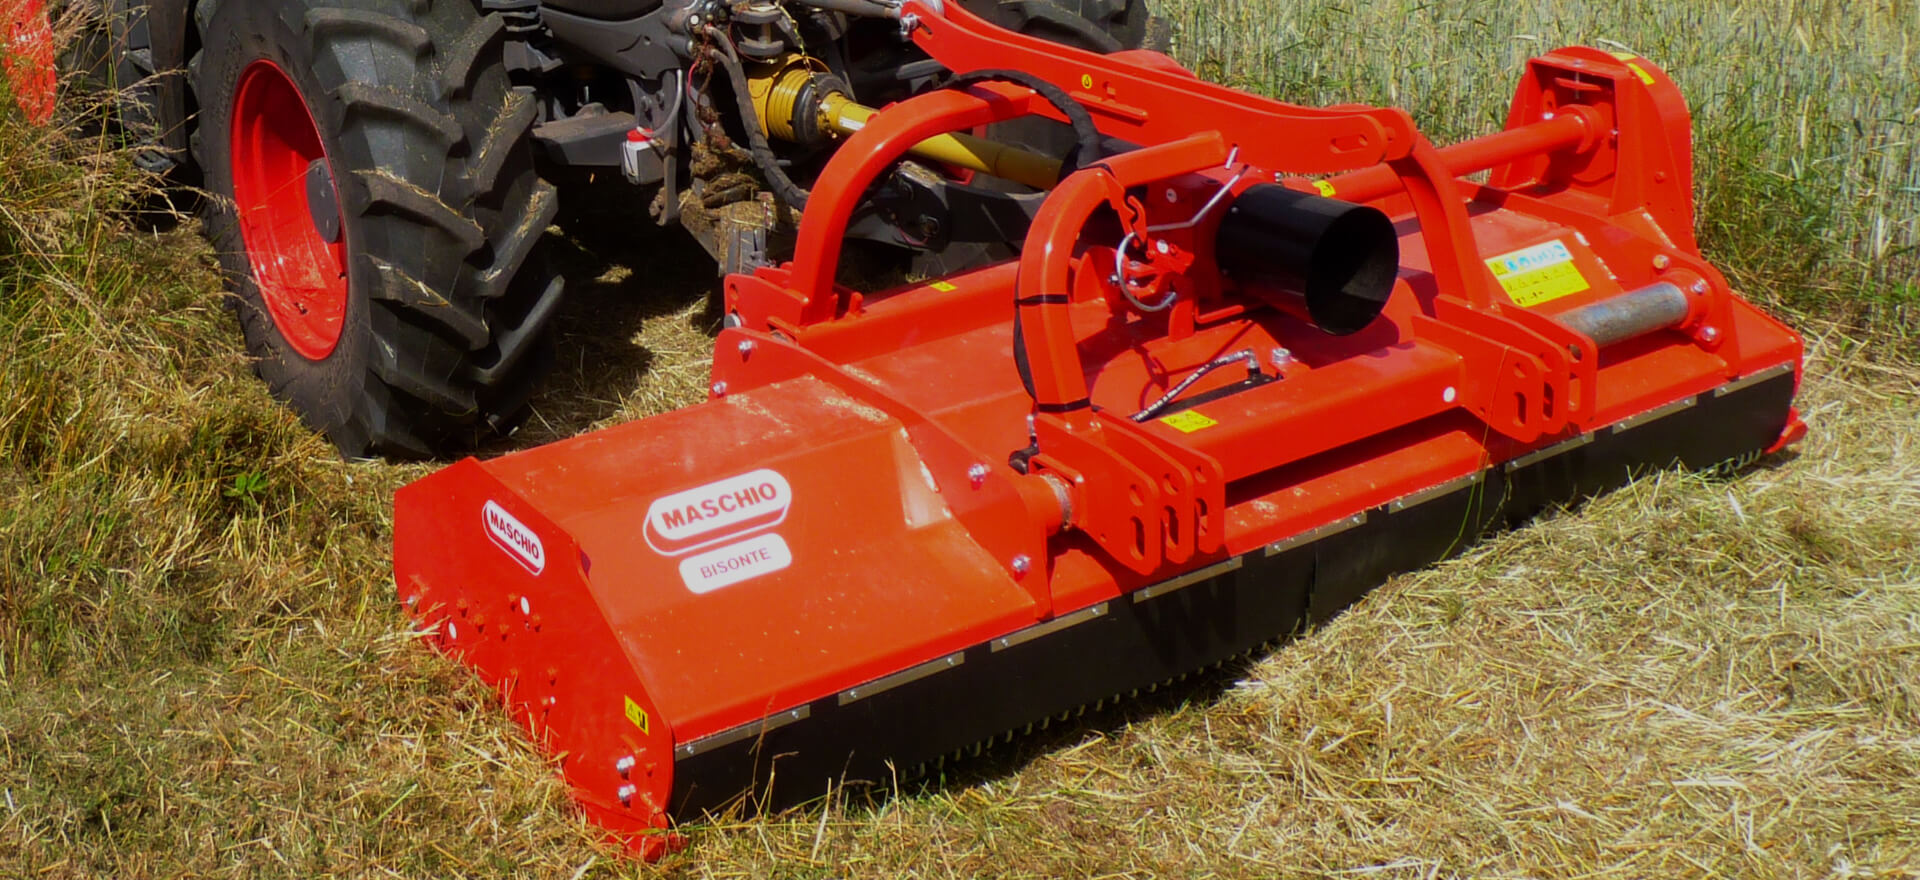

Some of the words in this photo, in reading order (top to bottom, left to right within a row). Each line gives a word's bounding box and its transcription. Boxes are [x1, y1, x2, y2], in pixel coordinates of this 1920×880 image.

[661, 482, 777, 530] MASCHIO
[489, 508, 540, 560] MASCHIO
[699, 547, 772, 579] BISONTE
